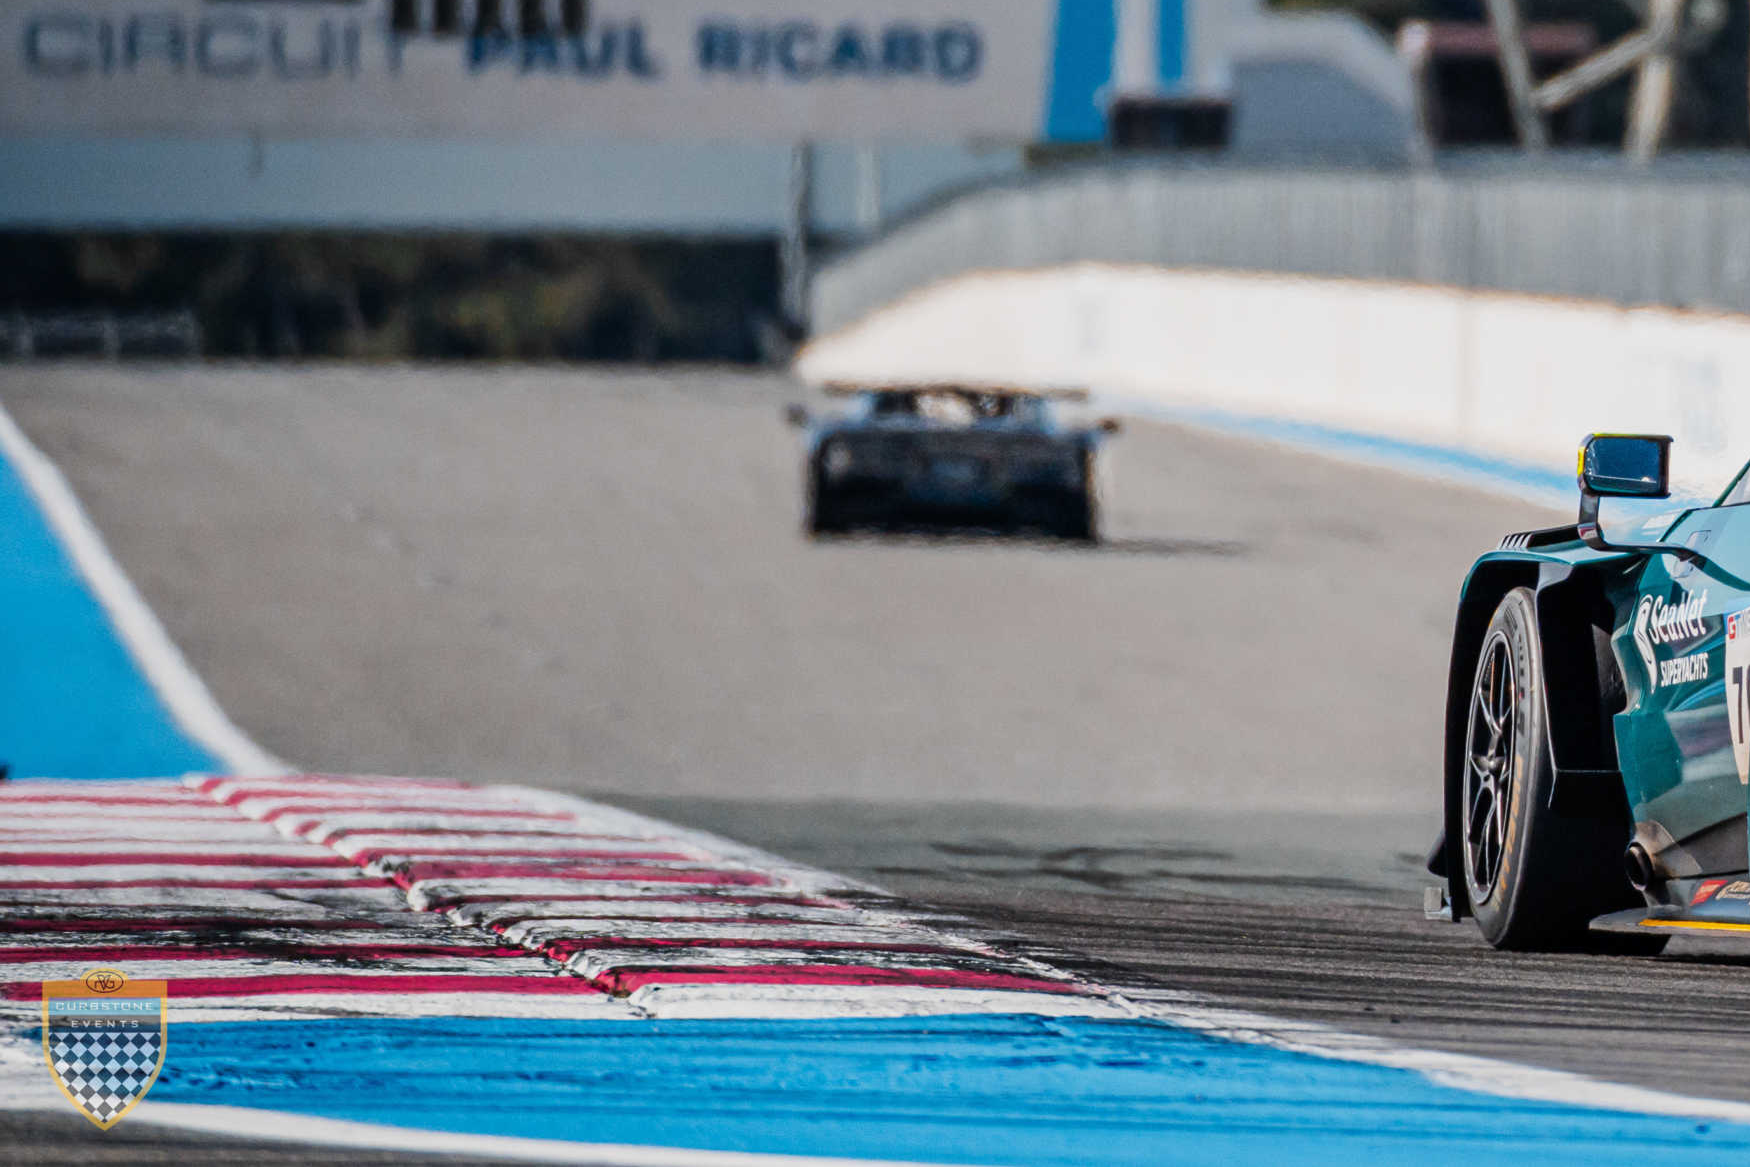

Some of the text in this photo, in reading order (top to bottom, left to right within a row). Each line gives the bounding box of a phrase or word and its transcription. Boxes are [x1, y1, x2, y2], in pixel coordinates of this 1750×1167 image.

[694, 18, 986, 82] RICARD
[1649, 589, 1708, 645] SeaNet
[1660, 652, 1709, 687] SUPERYACHTS
